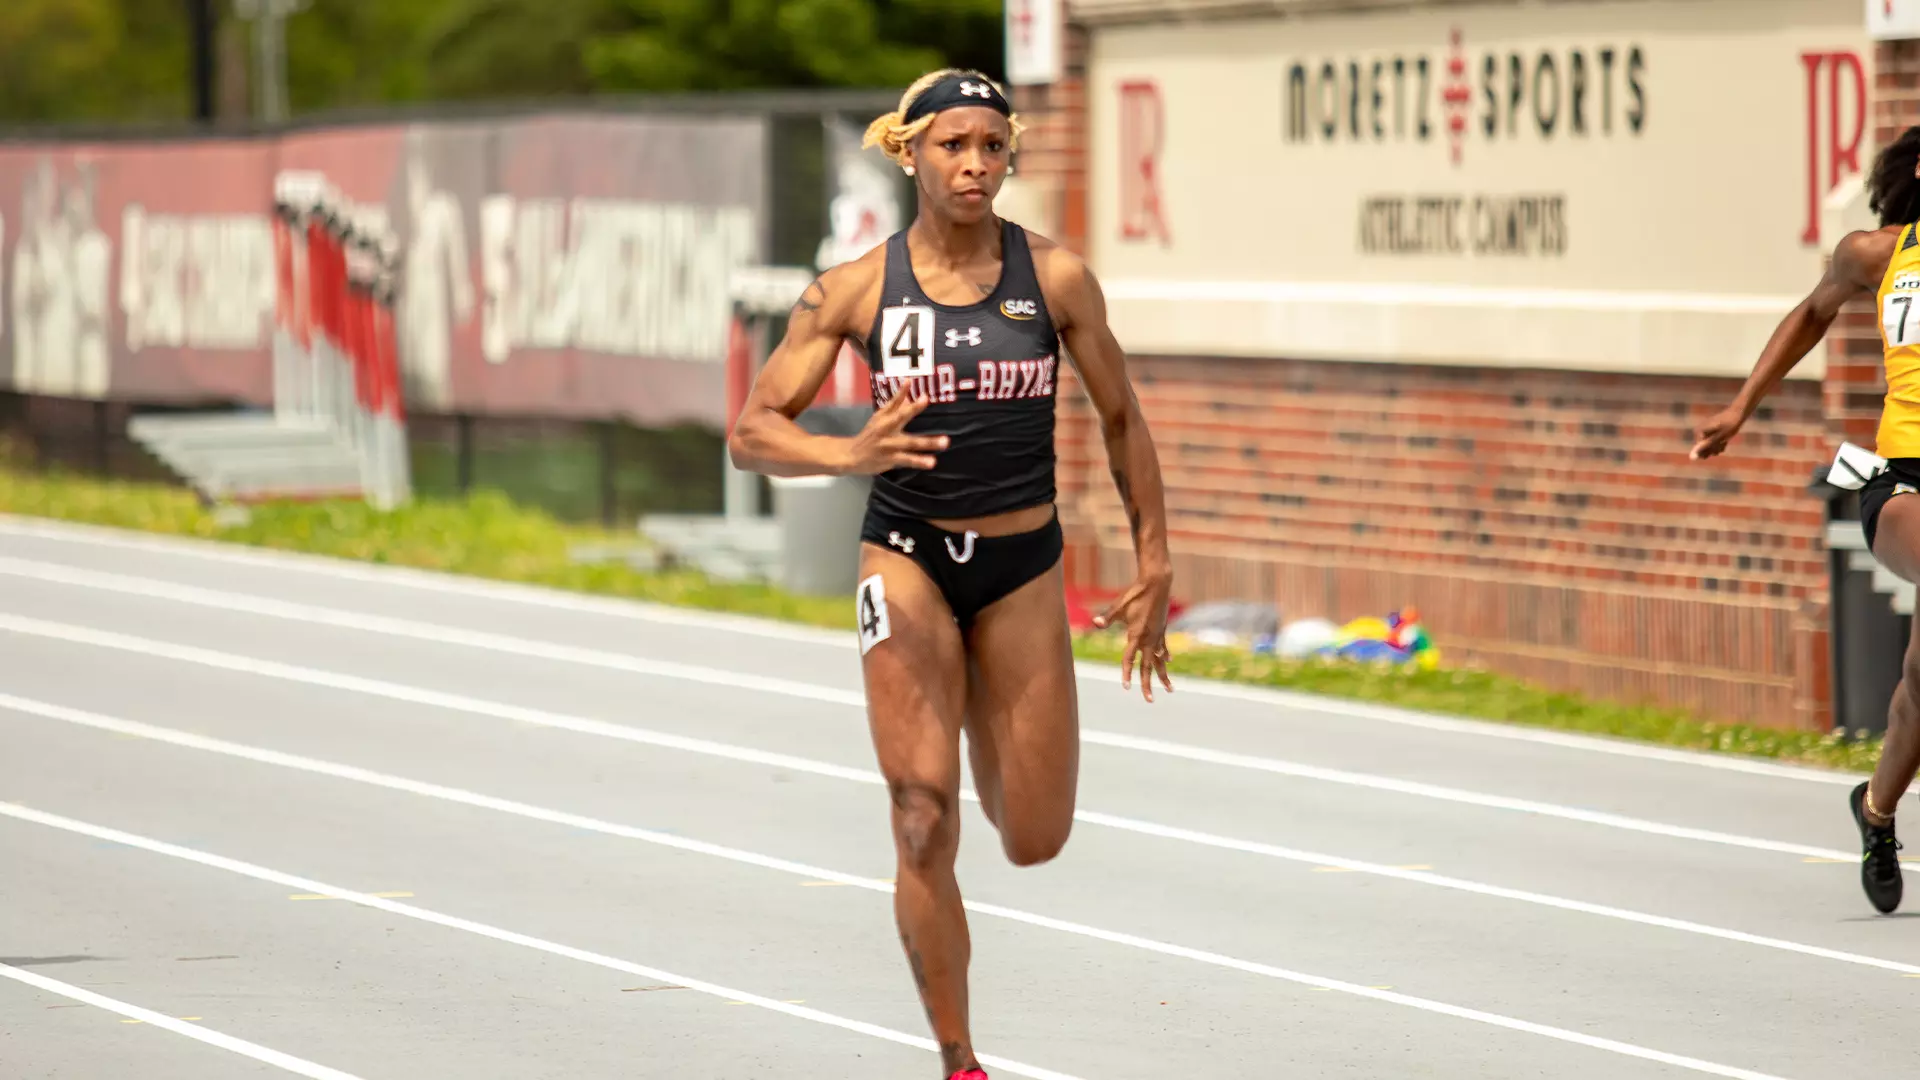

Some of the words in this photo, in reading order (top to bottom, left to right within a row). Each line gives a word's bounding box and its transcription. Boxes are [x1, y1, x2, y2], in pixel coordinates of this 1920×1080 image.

[1285, 56, 1432, 143] MORETZ
[1482, 44, 1650, 138] SPORTS
[1472, 194, 1567, 256] CAMPUS
[1004, 299, 1037, 315] SAC
[1892, 296, 1912, 343] 7
[890, 312, 924, 370] 4
[863, 583, 881, 637] 4
